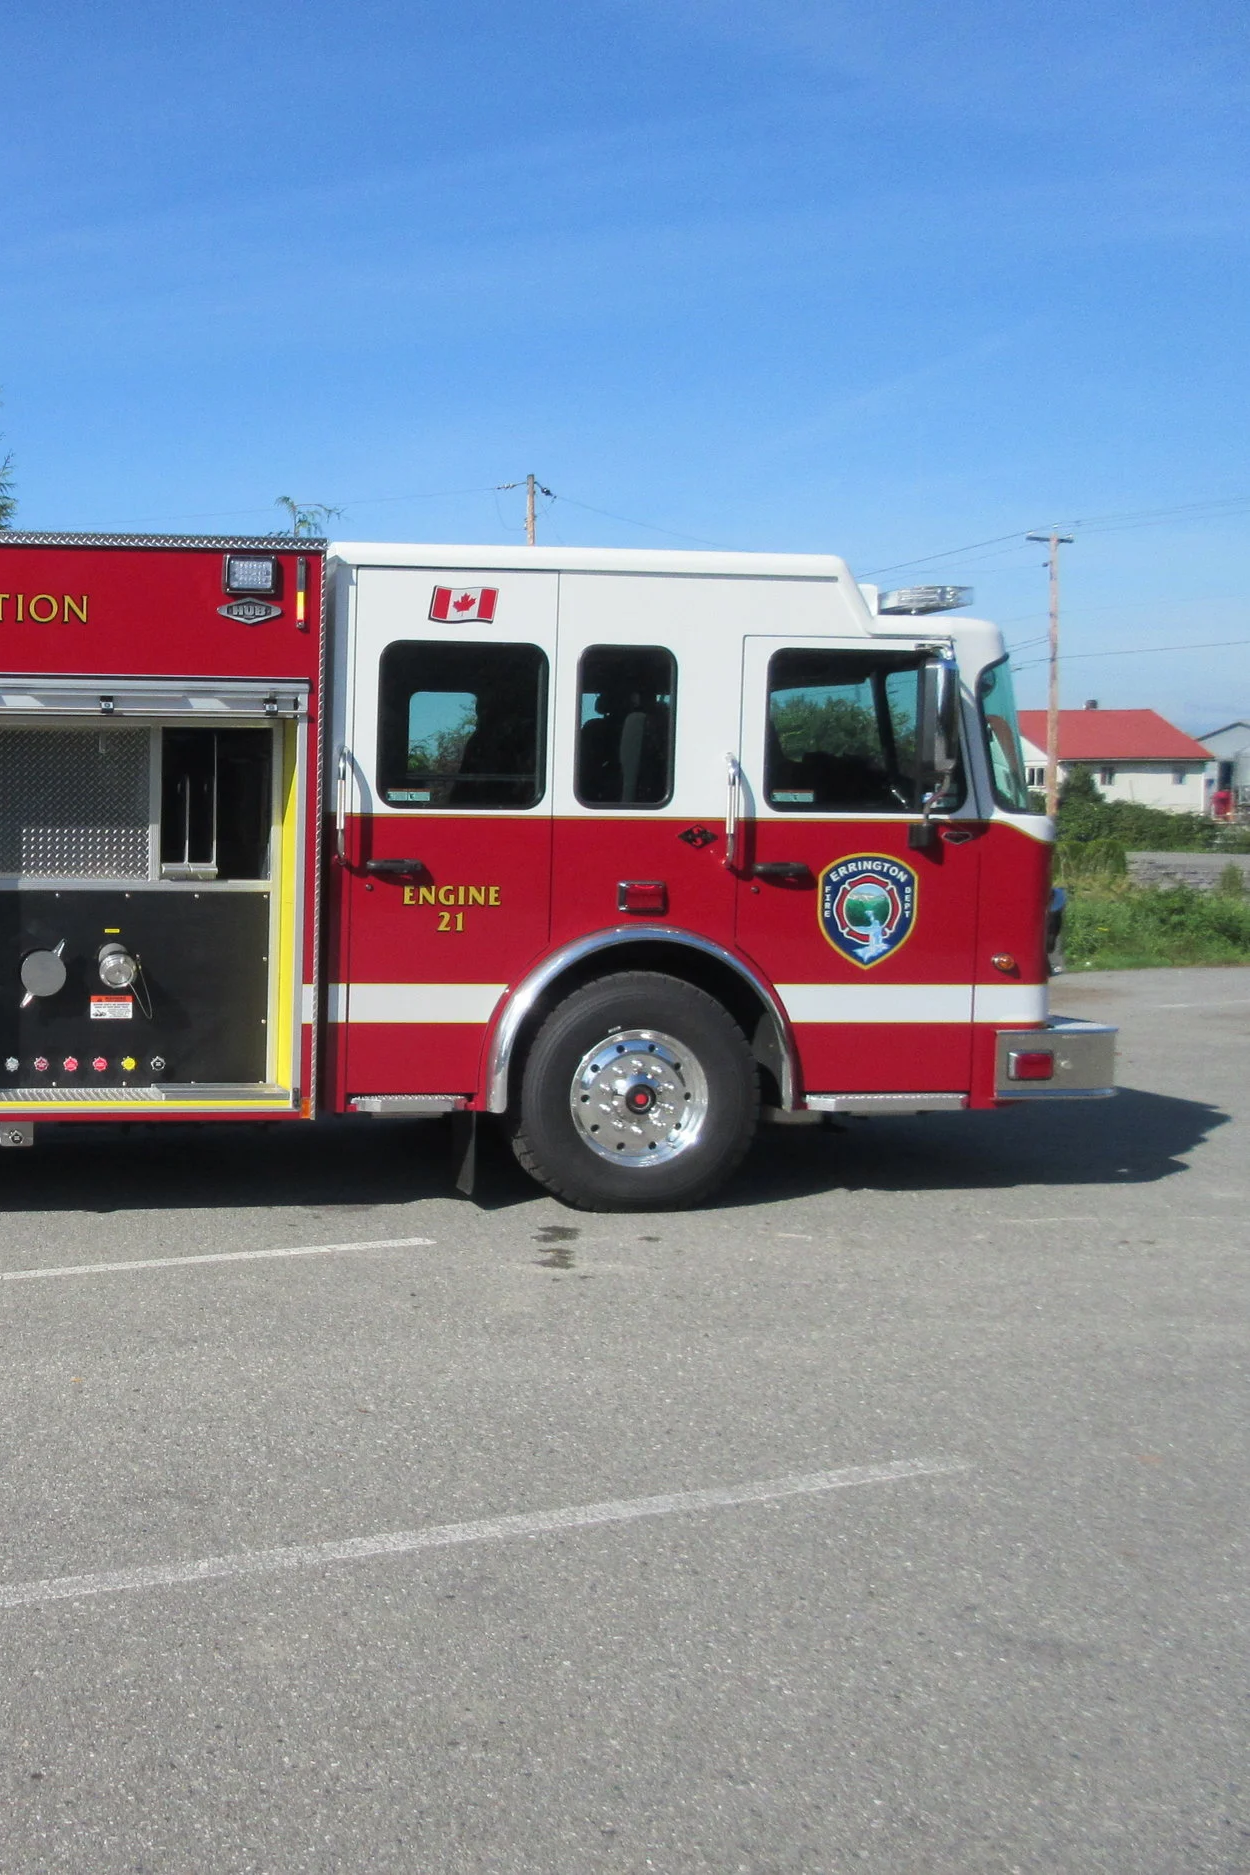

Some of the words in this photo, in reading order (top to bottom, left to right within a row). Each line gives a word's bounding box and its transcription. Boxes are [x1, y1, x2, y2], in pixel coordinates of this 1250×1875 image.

[233, 605, 266, 616] HUB
[830, 861, 908, 882] ERRINGTON
[403, 885, 501, 906] ENGINE
[437, 911, 464, 931] 21
